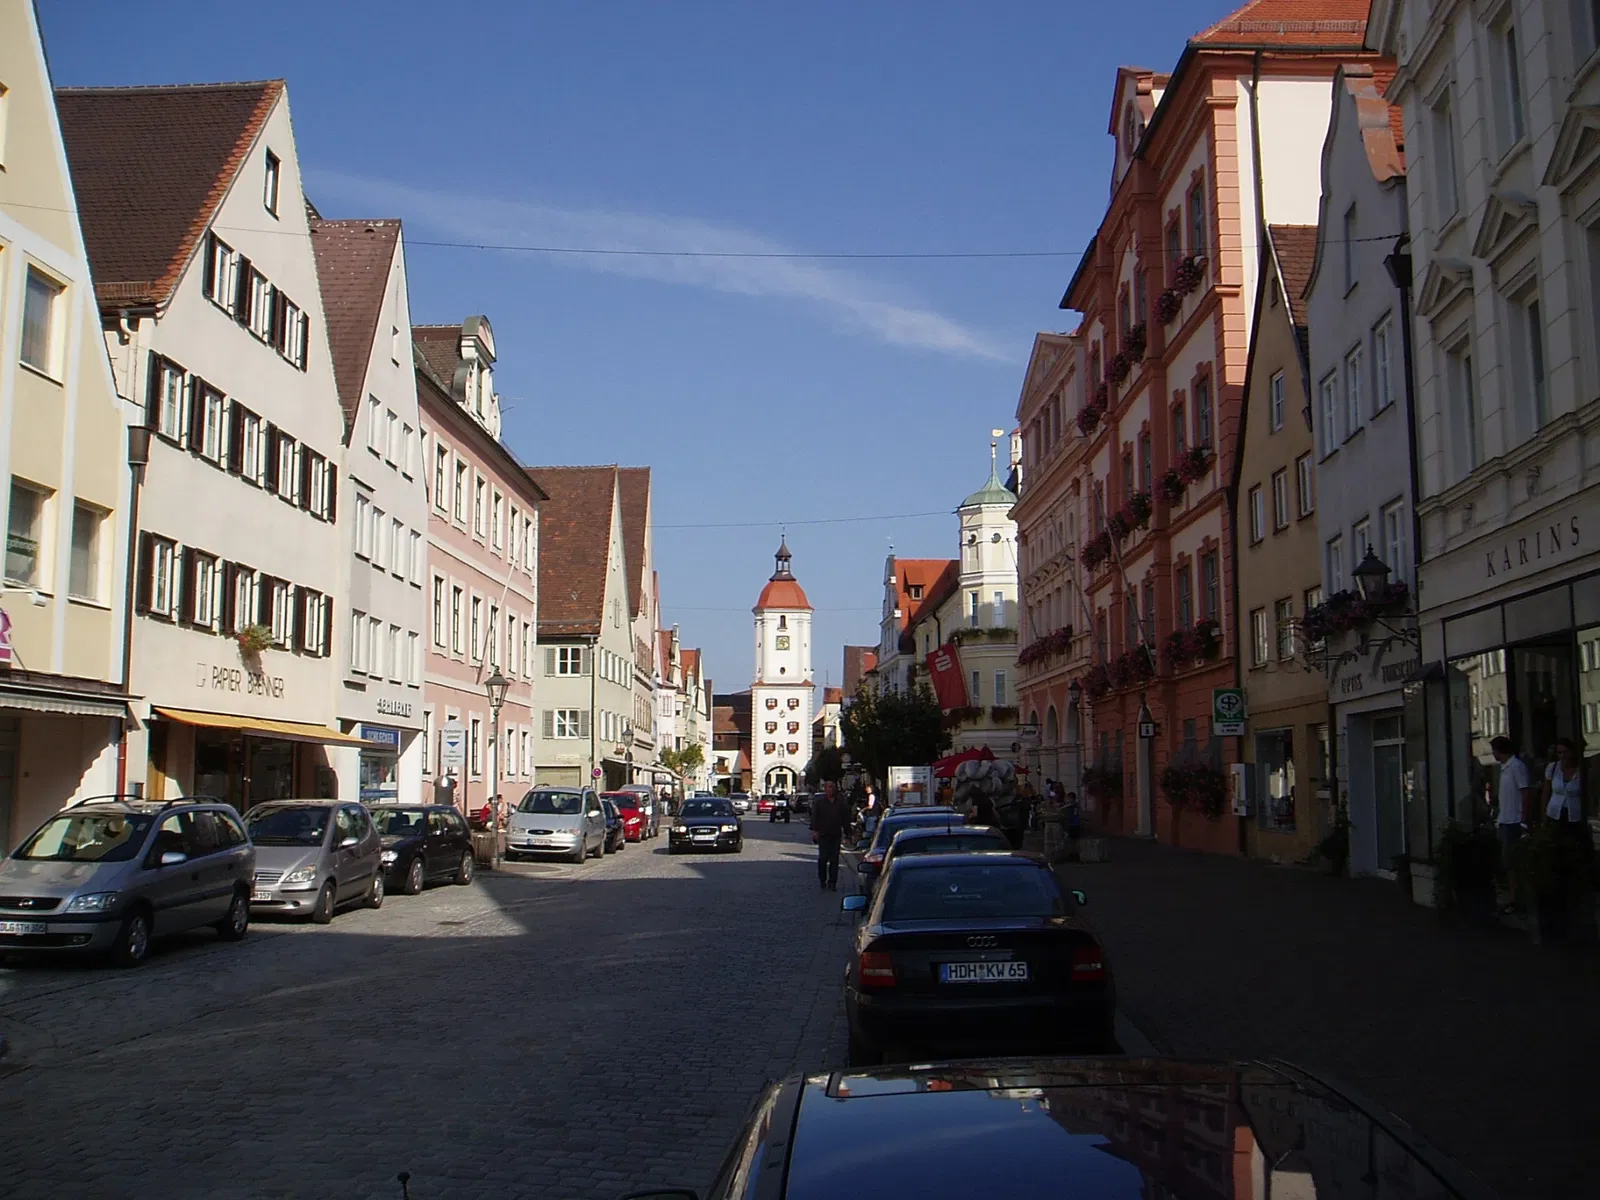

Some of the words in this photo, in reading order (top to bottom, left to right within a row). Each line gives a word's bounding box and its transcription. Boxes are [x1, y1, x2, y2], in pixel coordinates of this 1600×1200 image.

[1486, 516, 1580, 577] KARINS
[212, 666, 241, 692] PAPIER
[247, 671, 284, 699] BRENNER
[949, 964, 977, 978] HDH
[986, 964, 1005, 977] KW
[1009, 963, 1026, 977] 65
